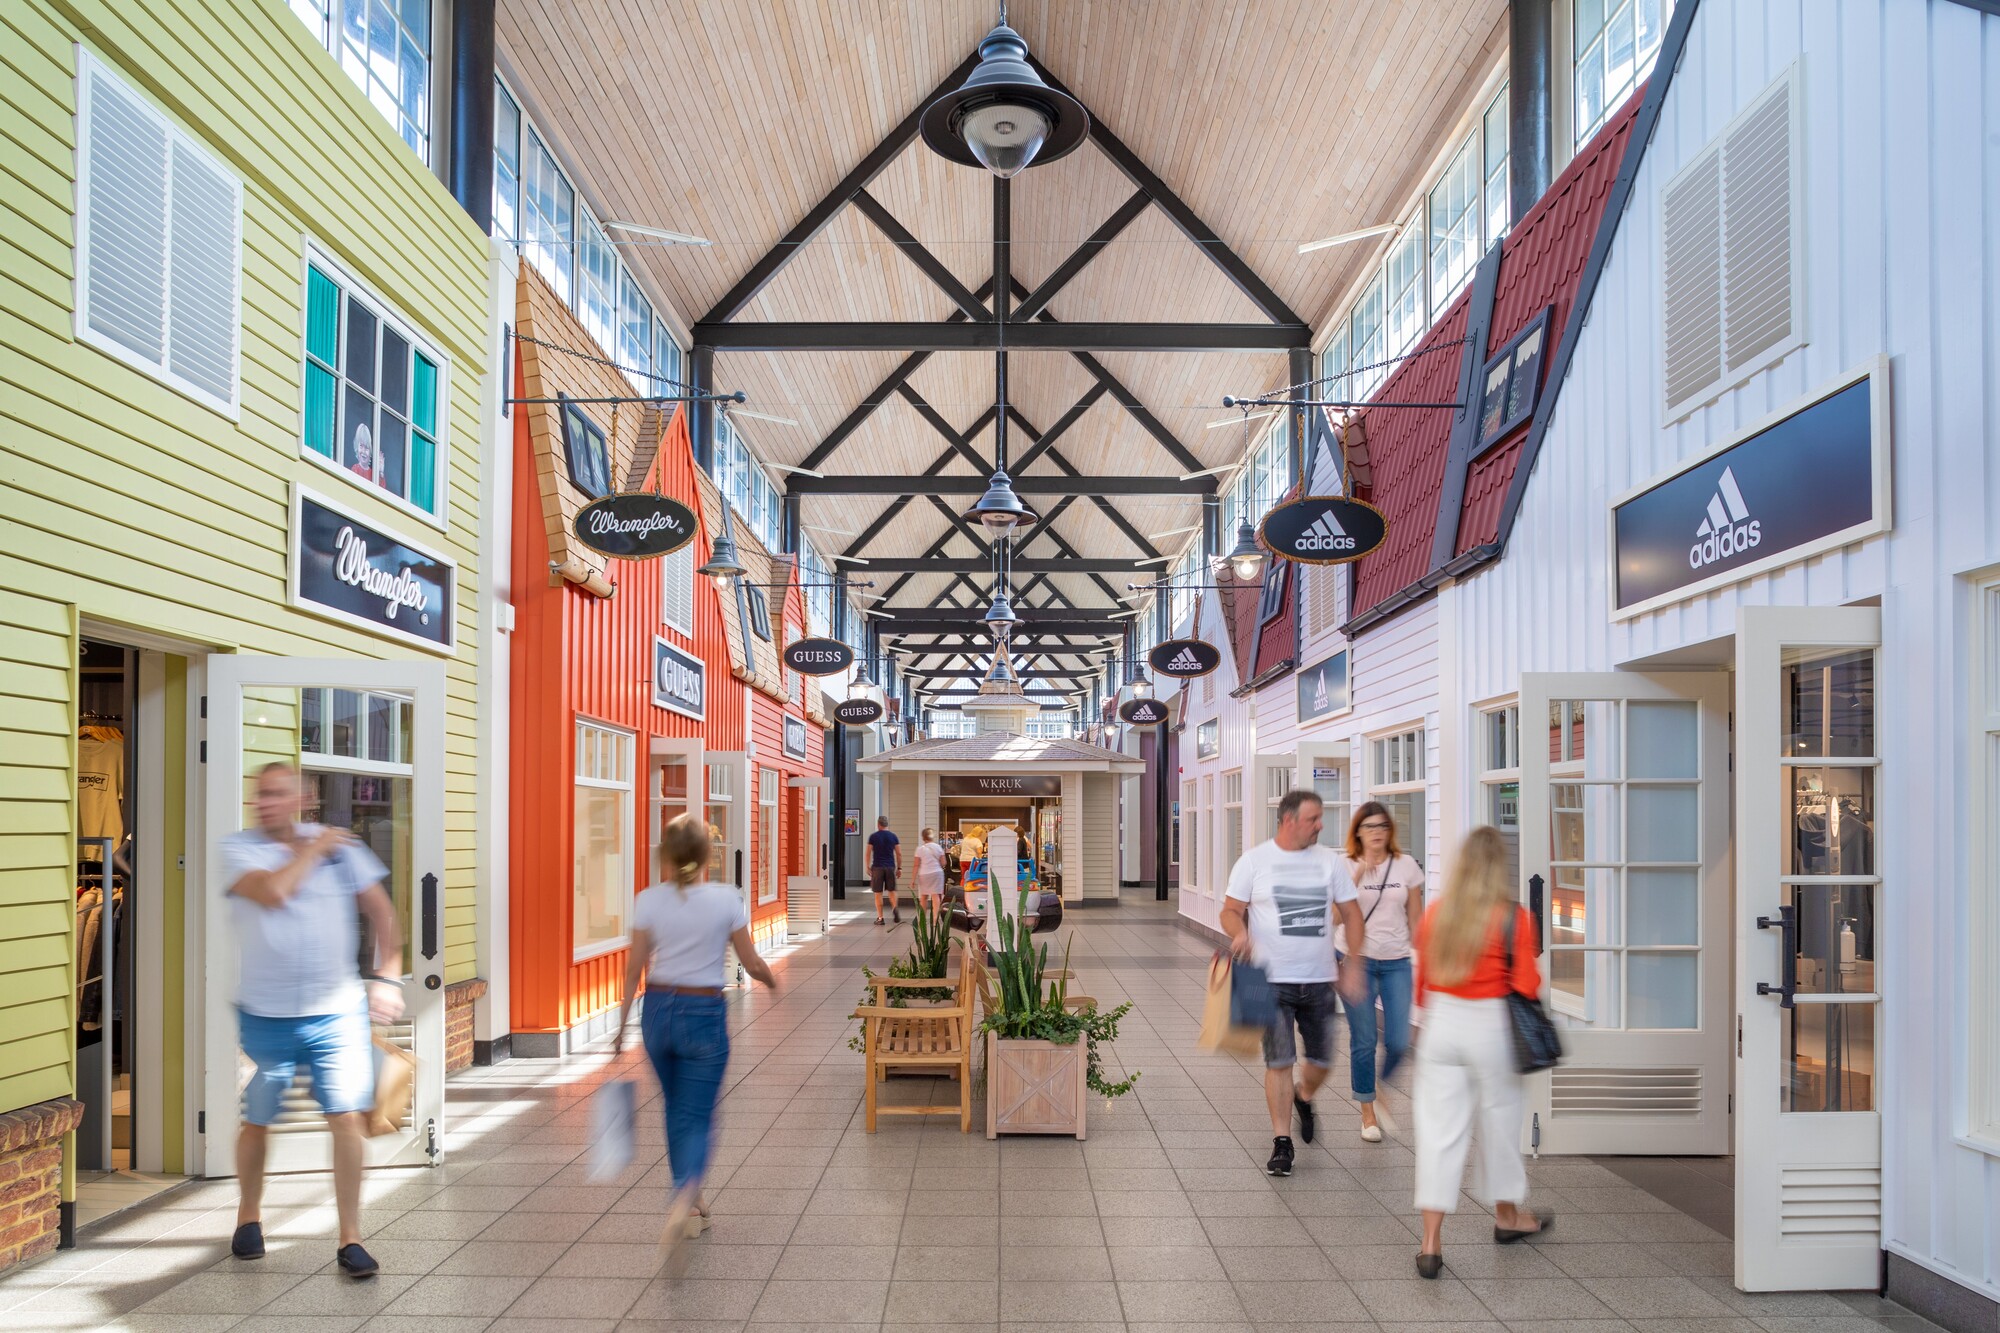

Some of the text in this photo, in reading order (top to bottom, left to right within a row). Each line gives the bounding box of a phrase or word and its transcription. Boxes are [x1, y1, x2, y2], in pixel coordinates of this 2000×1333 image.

[590, 509, 679, 540] Wrangler
[1295, 535, 1355, 550] adidas
[1689, 520, 1762, 569] adidas
[335, 526, 427, 619] Wrangler
[793, 651, 842, 663] GUESS
[1167, 660, 1203, 671] adidas
[661, 656, 700, 706] GUESS
[1314, 695, 1329, 711] adidas
[840, 706, 875, 717] GUESS
[1132, 713, 1157, 721] adidas
